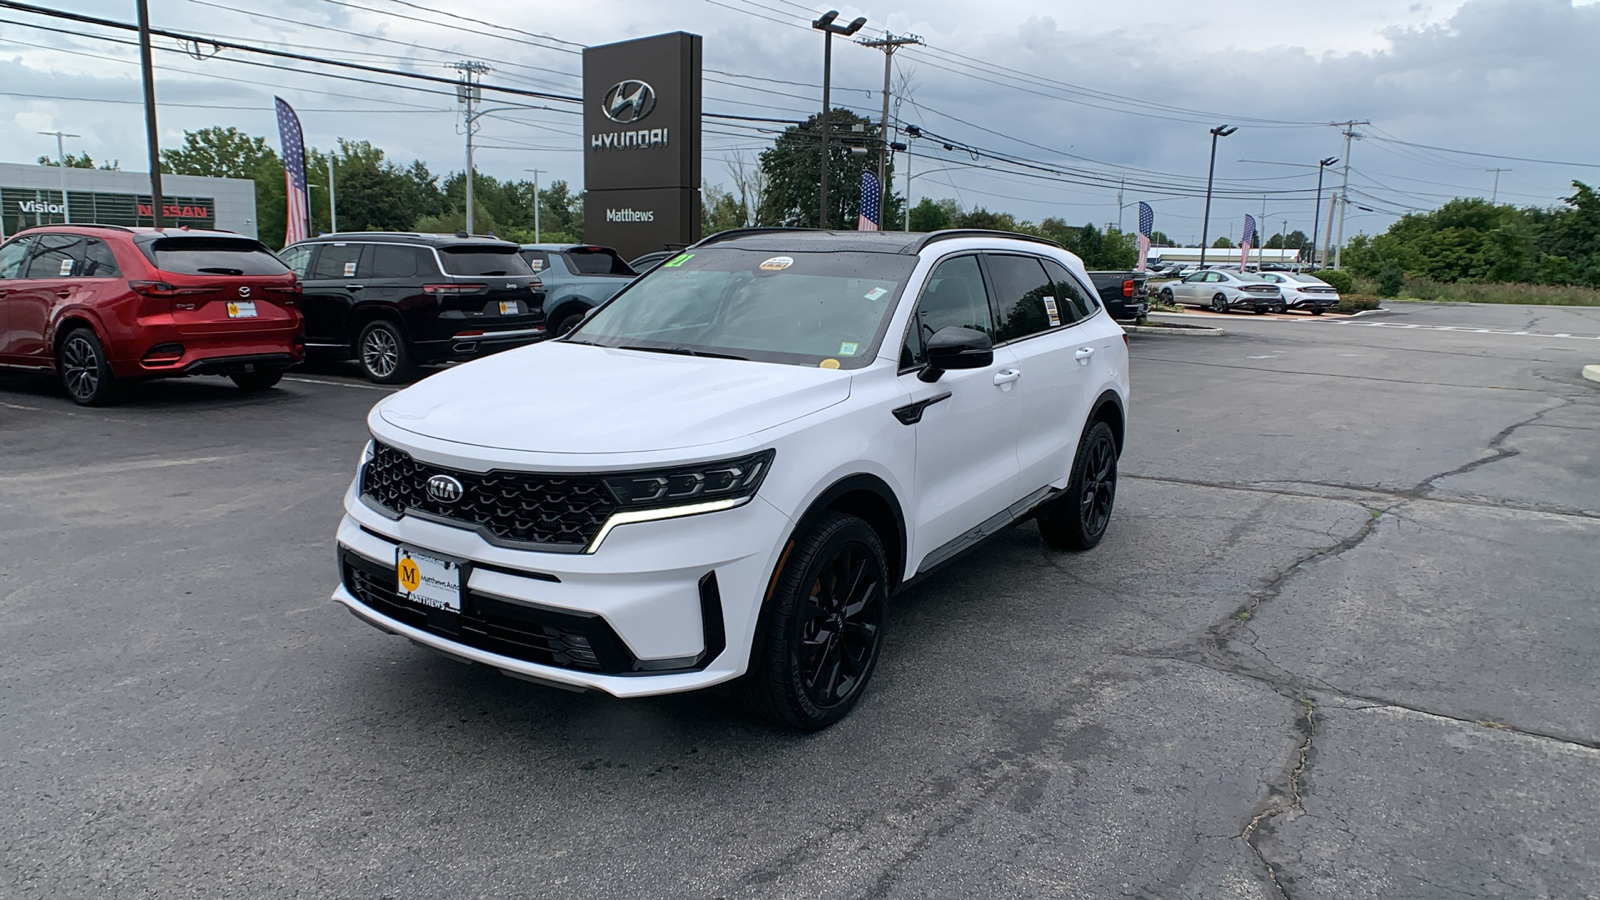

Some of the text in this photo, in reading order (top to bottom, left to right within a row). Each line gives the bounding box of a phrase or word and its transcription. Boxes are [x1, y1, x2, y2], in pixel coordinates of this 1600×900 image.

[592, 128, 668, 148] HYUNDAI
[18, 200, 65, 214] Vision
[137, 203, 207, 218] NSSAN
[606, 208, 654, 222] Matthews
[430, 480, 455, 499] KIA
[402, 565, 416, 585] M
